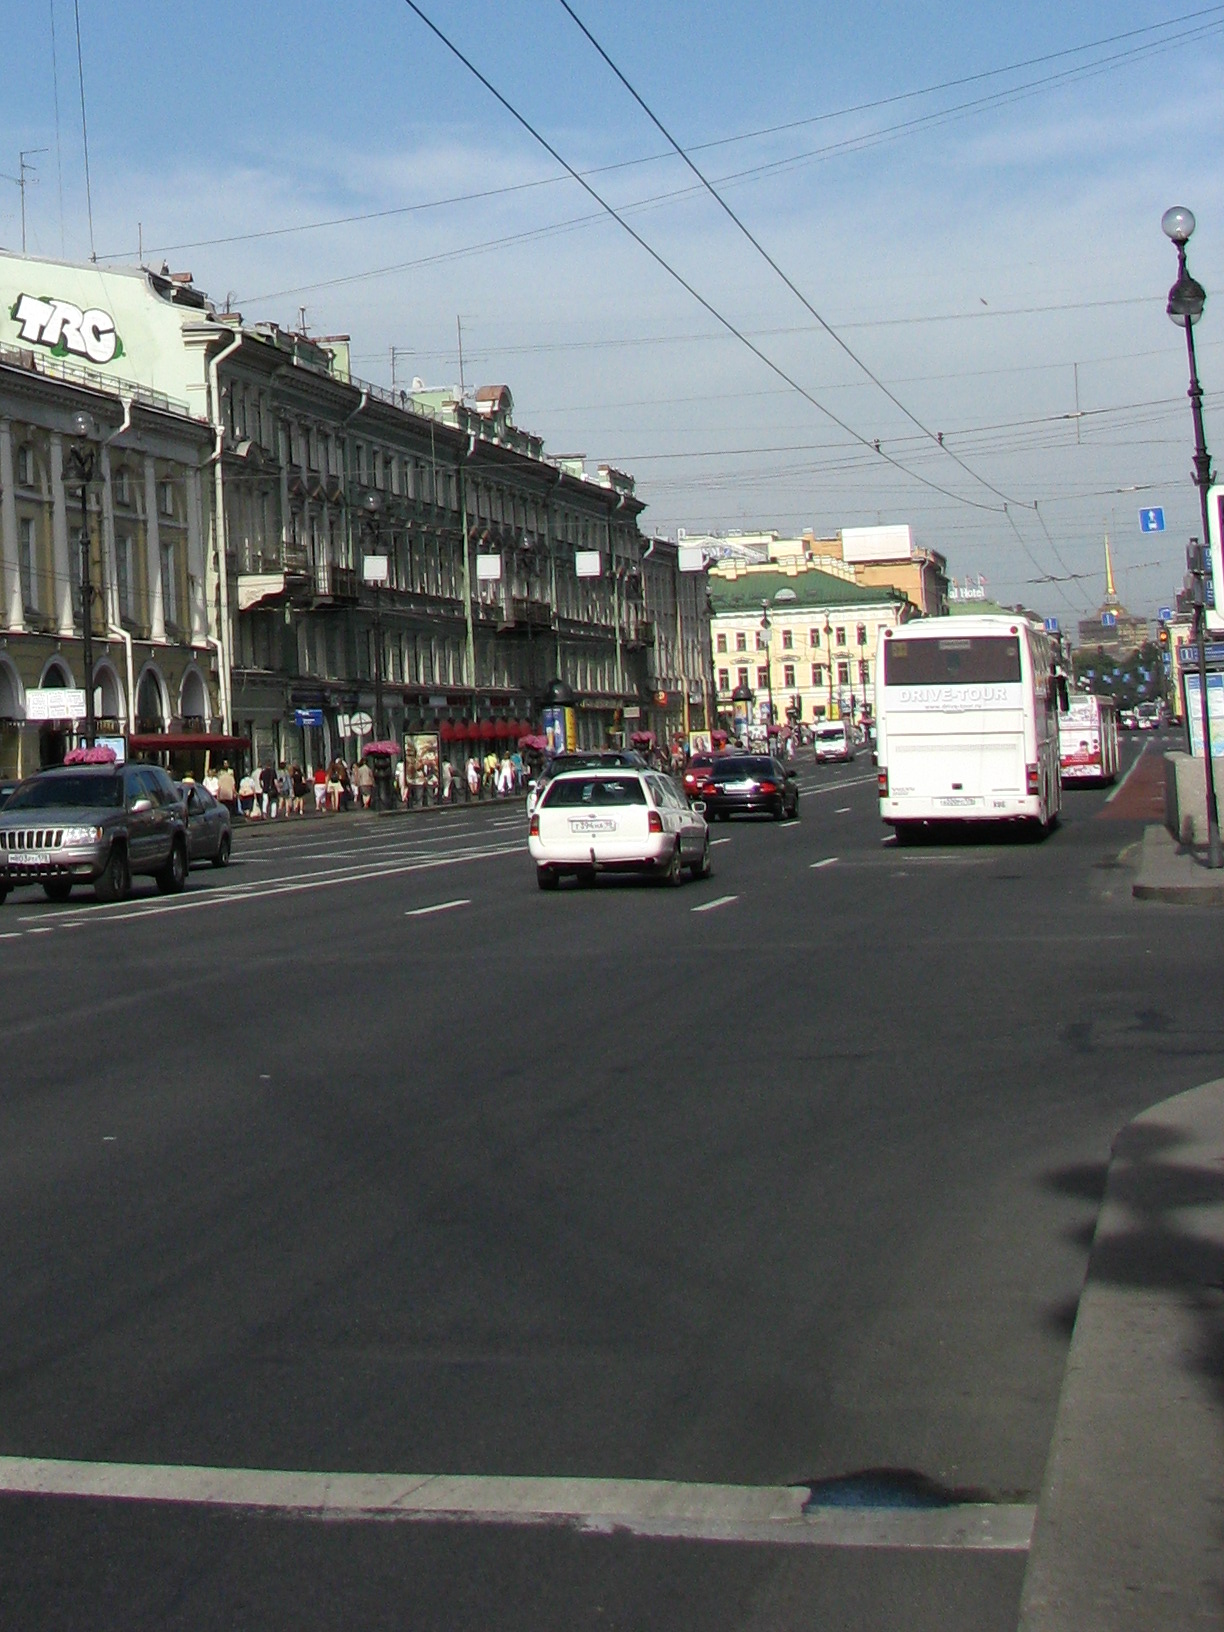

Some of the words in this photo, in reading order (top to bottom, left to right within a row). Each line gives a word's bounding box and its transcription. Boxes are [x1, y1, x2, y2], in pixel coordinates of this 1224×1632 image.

[12, 292, 117, 364] TRC
[960, 585, 985, 598] Hotel
[899, 687, 1008, 703] DRIVE-TOUR
